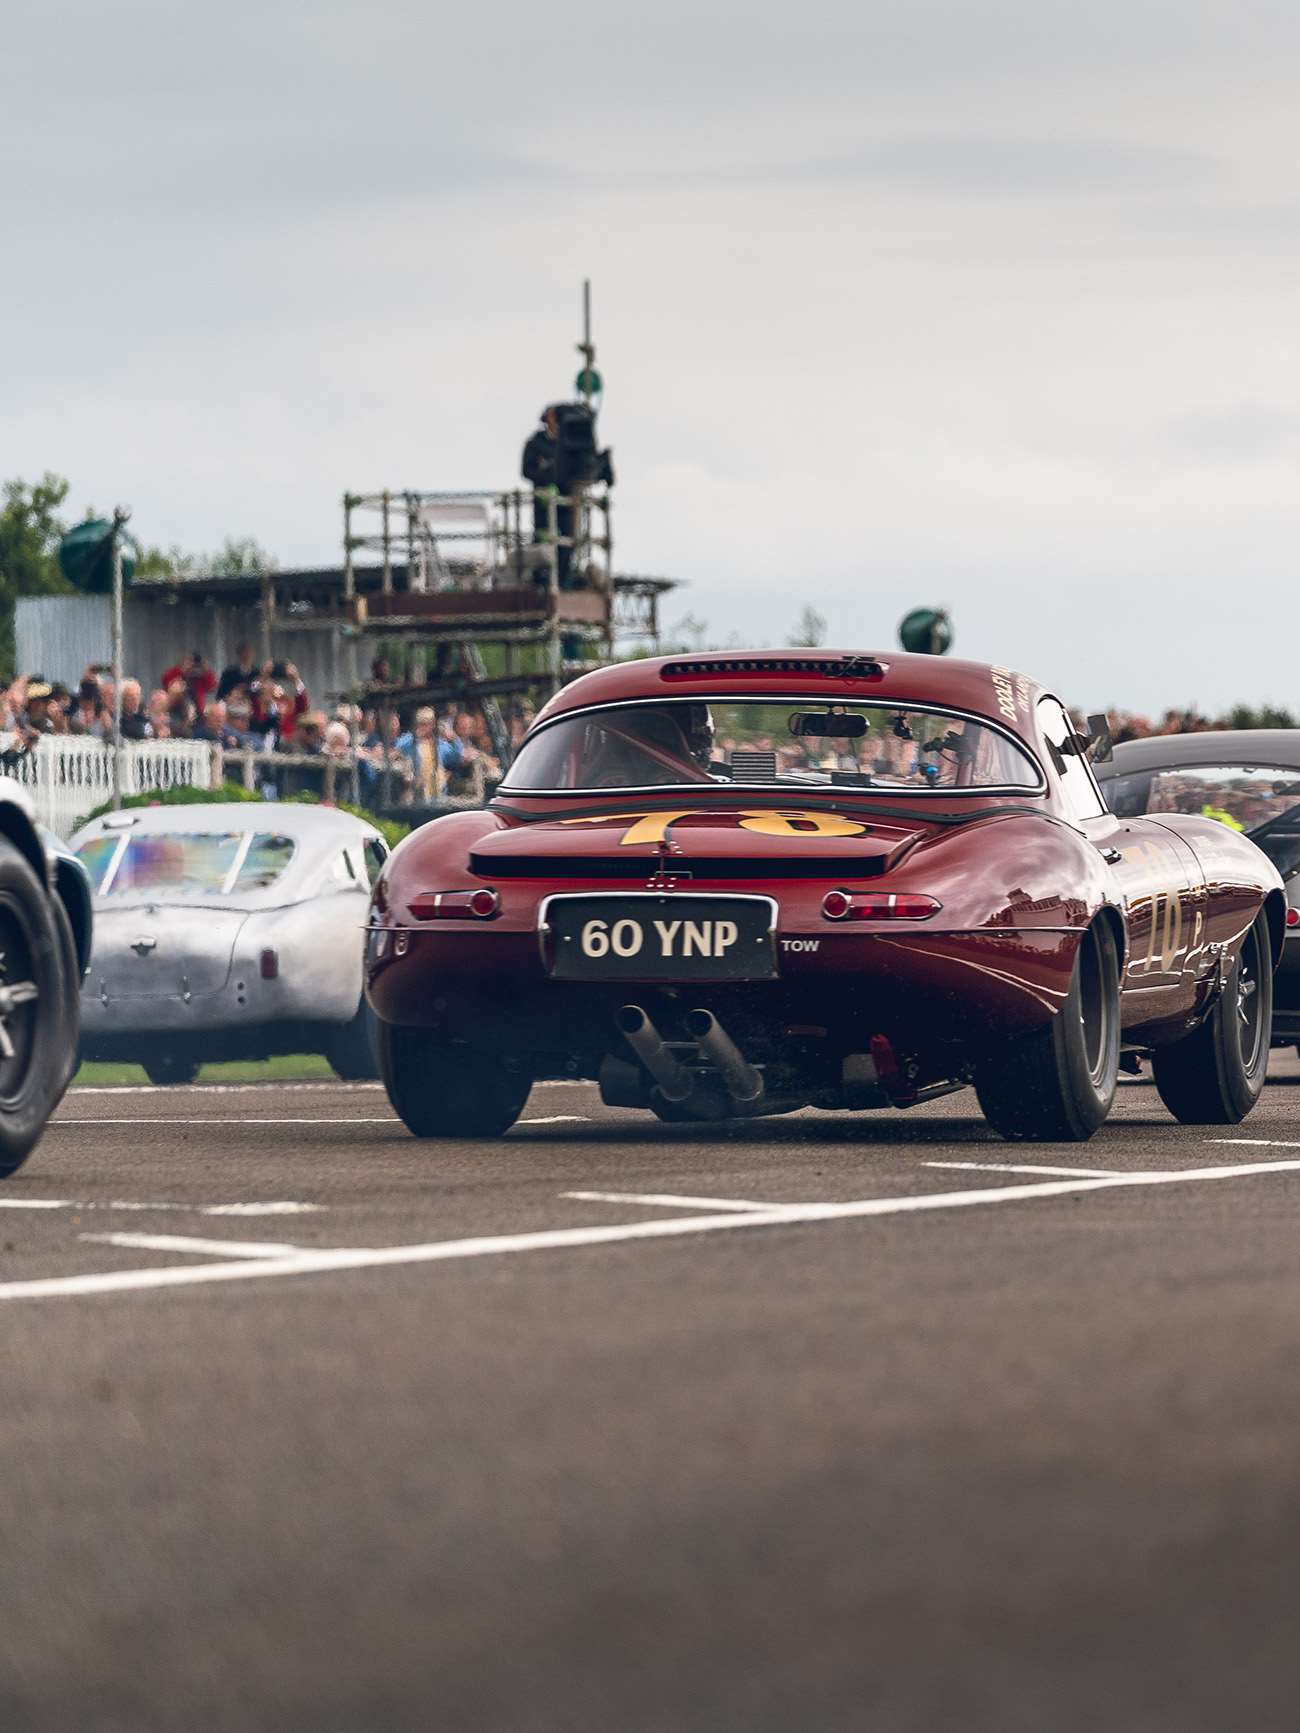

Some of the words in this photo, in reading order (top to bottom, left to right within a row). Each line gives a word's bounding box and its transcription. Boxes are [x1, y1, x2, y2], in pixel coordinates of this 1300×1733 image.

[582, 919, 644, 957] 60
[653, 920, 738, 957] YNP
[780, 940, 820, 952] TOW
